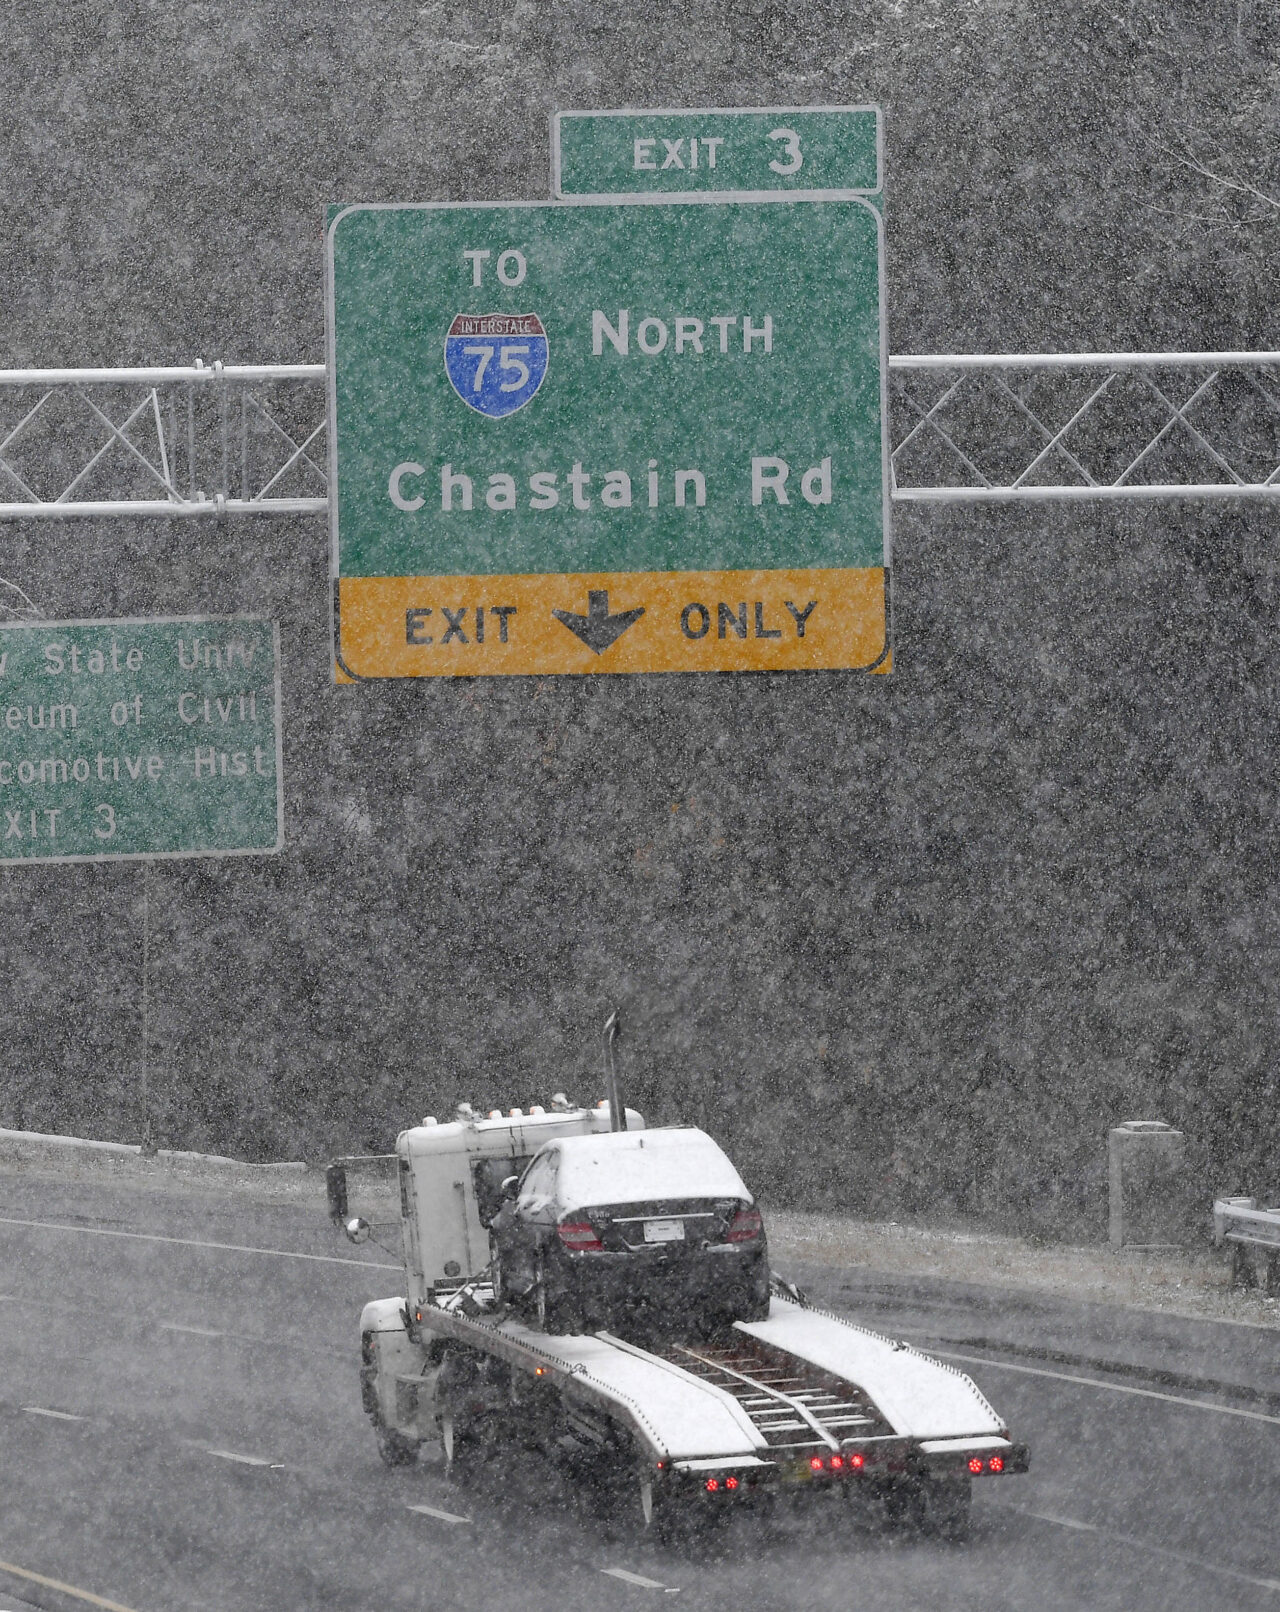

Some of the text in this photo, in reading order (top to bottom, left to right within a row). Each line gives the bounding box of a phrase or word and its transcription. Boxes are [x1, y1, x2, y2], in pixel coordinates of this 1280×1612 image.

[634, 128, 803, 175] EXIT 3
[463, 249, 527, 287] TO
[461, 319, 532, 334] INTERSTATE
[463, 345, 529, 393] 75
[388, 456, 832, 511] Chastain Rd
[405, 600, 818, 645] EXIT ONLY
[44, 643, 144, 675] State
[111, 695, 143, 727] of
[178, 691, 256, 724] Civil
[194, 745, 270, 778] Hist
[94, 804, 118, 839] 3
